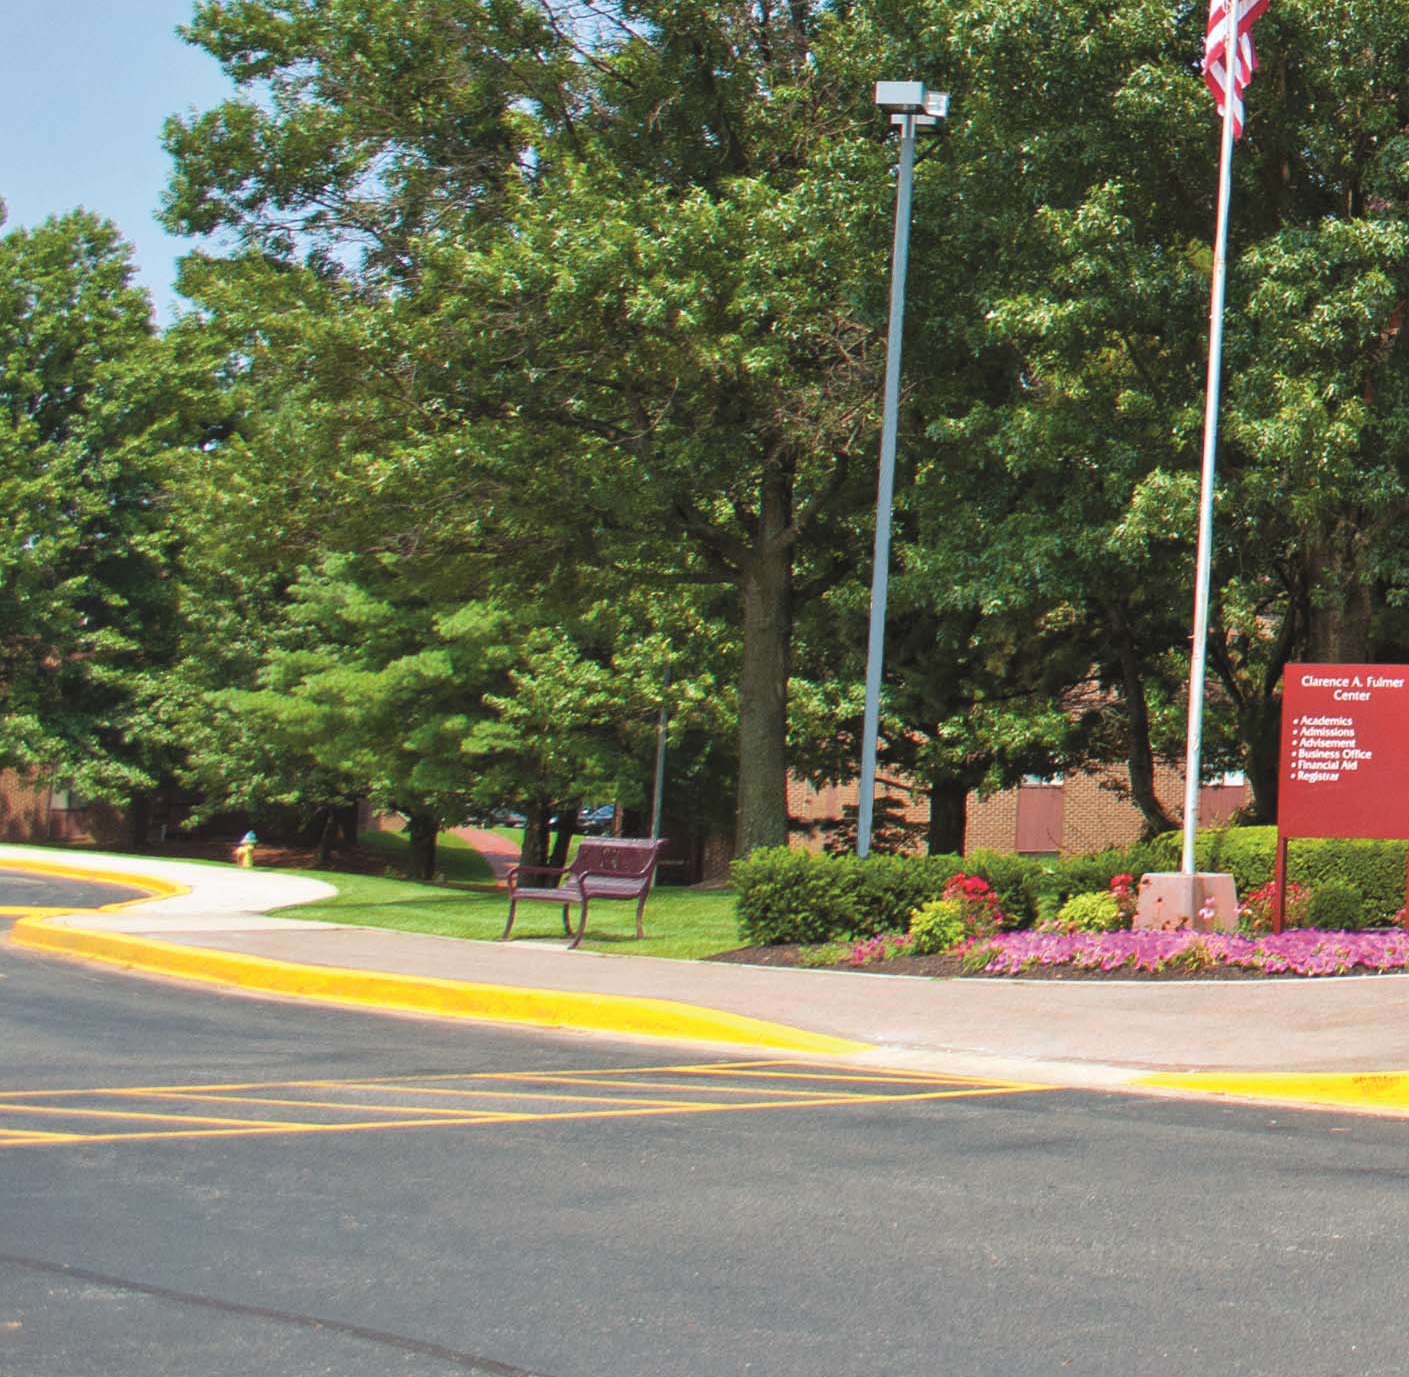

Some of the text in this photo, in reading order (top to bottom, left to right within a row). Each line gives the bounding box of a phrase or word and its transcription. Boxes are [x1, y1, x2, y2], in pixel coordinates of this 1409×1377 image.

[1301, 675, 1404, 688] Clarence A. Fulmer
[1333, 689, 1371, 701] Center
[1300, 715, 1353, 726] Academics
[1299, 726, 1355, 737] Admissions
[1299, 737, 1356, 748] Advisement
[1298, 748, 1372, 760] Business Office
[1297, 759, 1358, 770] Financial Aid
[1297, 770, 1340, 783] Registrar
